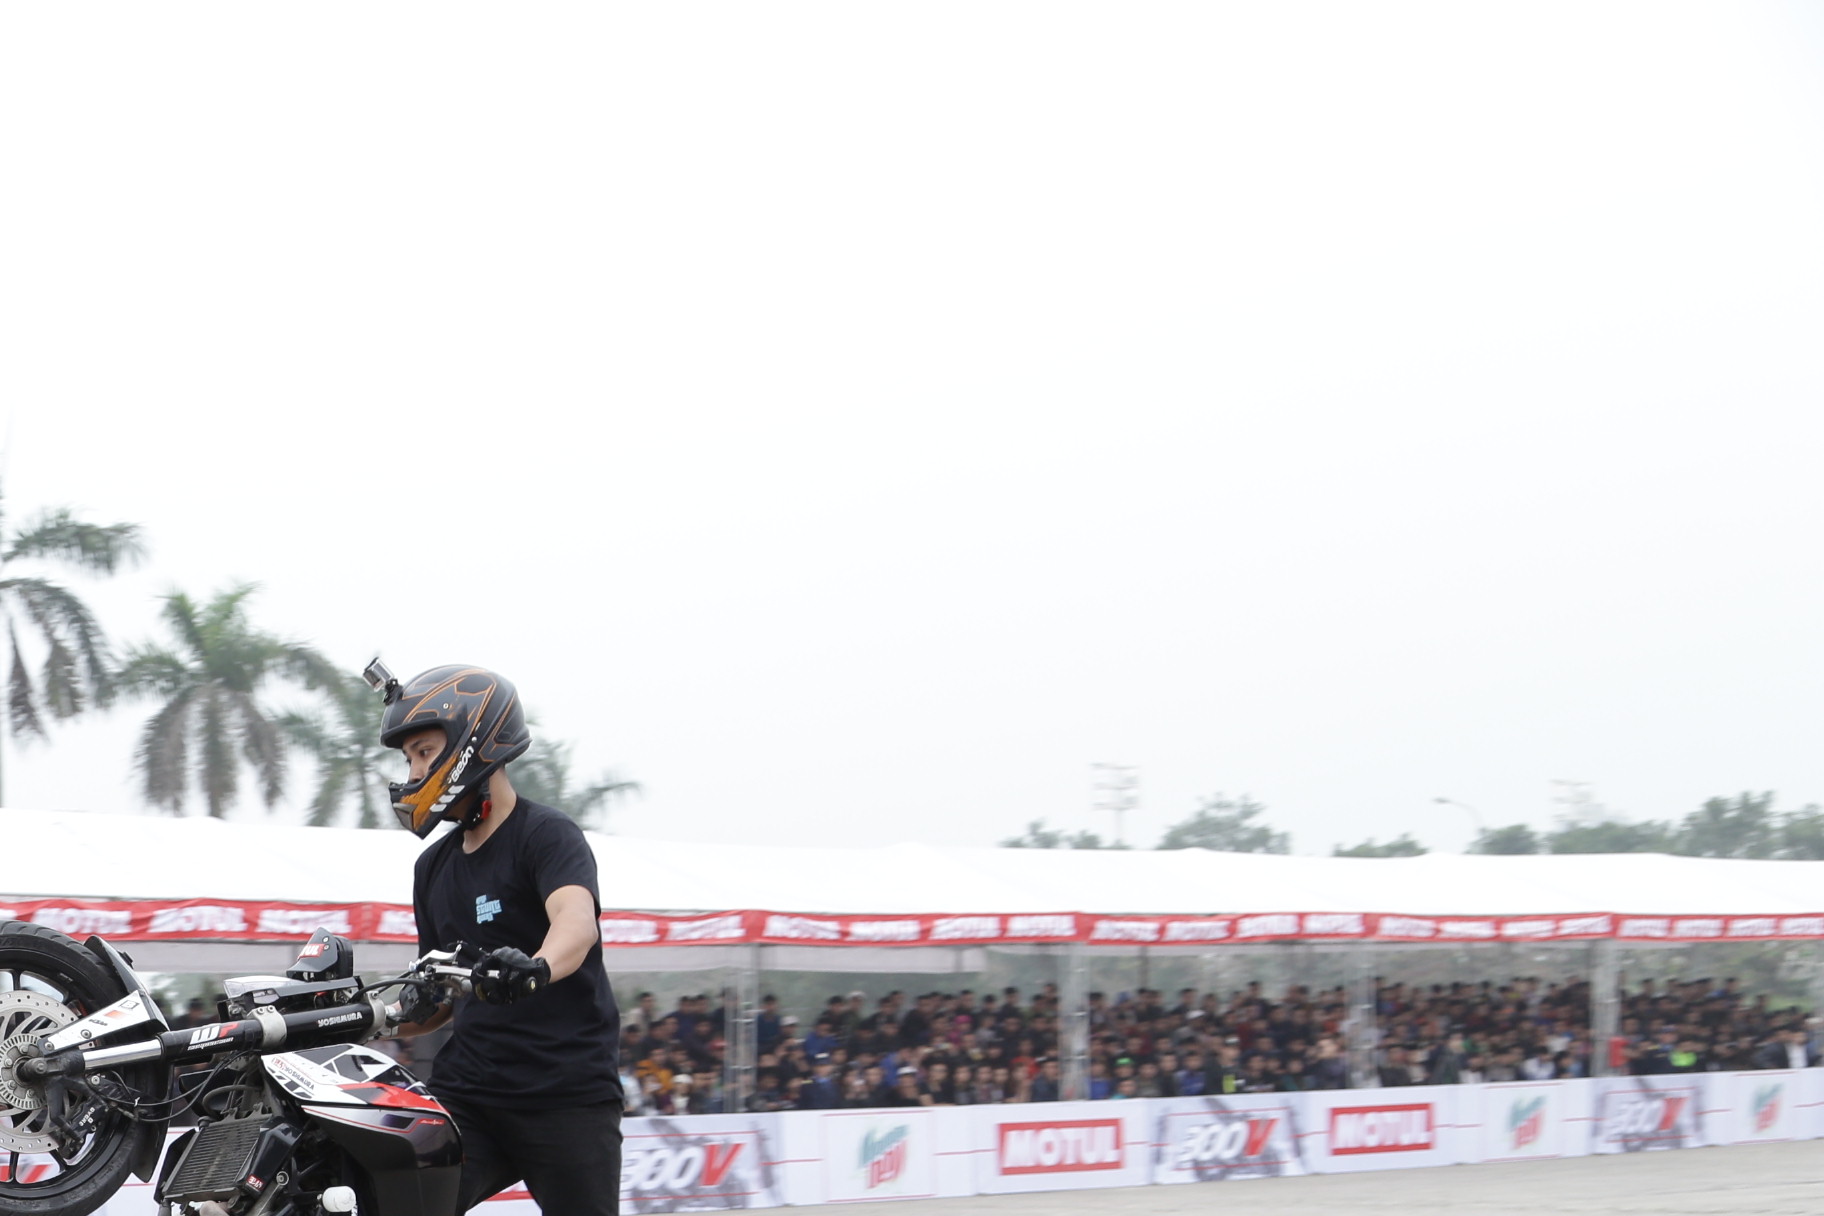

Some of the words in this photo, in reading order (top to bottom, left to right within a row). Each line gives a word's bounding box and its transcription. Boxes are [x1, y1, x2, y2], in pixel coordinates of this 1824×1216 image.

[189, 1022, 240, 1045] WP
[317, 1011, 363, 1028] YOSHIMURA
[1000, 1125, 1120, 1167] MOTUL
[1179, 1117, 1279, 1162] 300V
[1334, 1109, 1432, 1149] MOTUL
